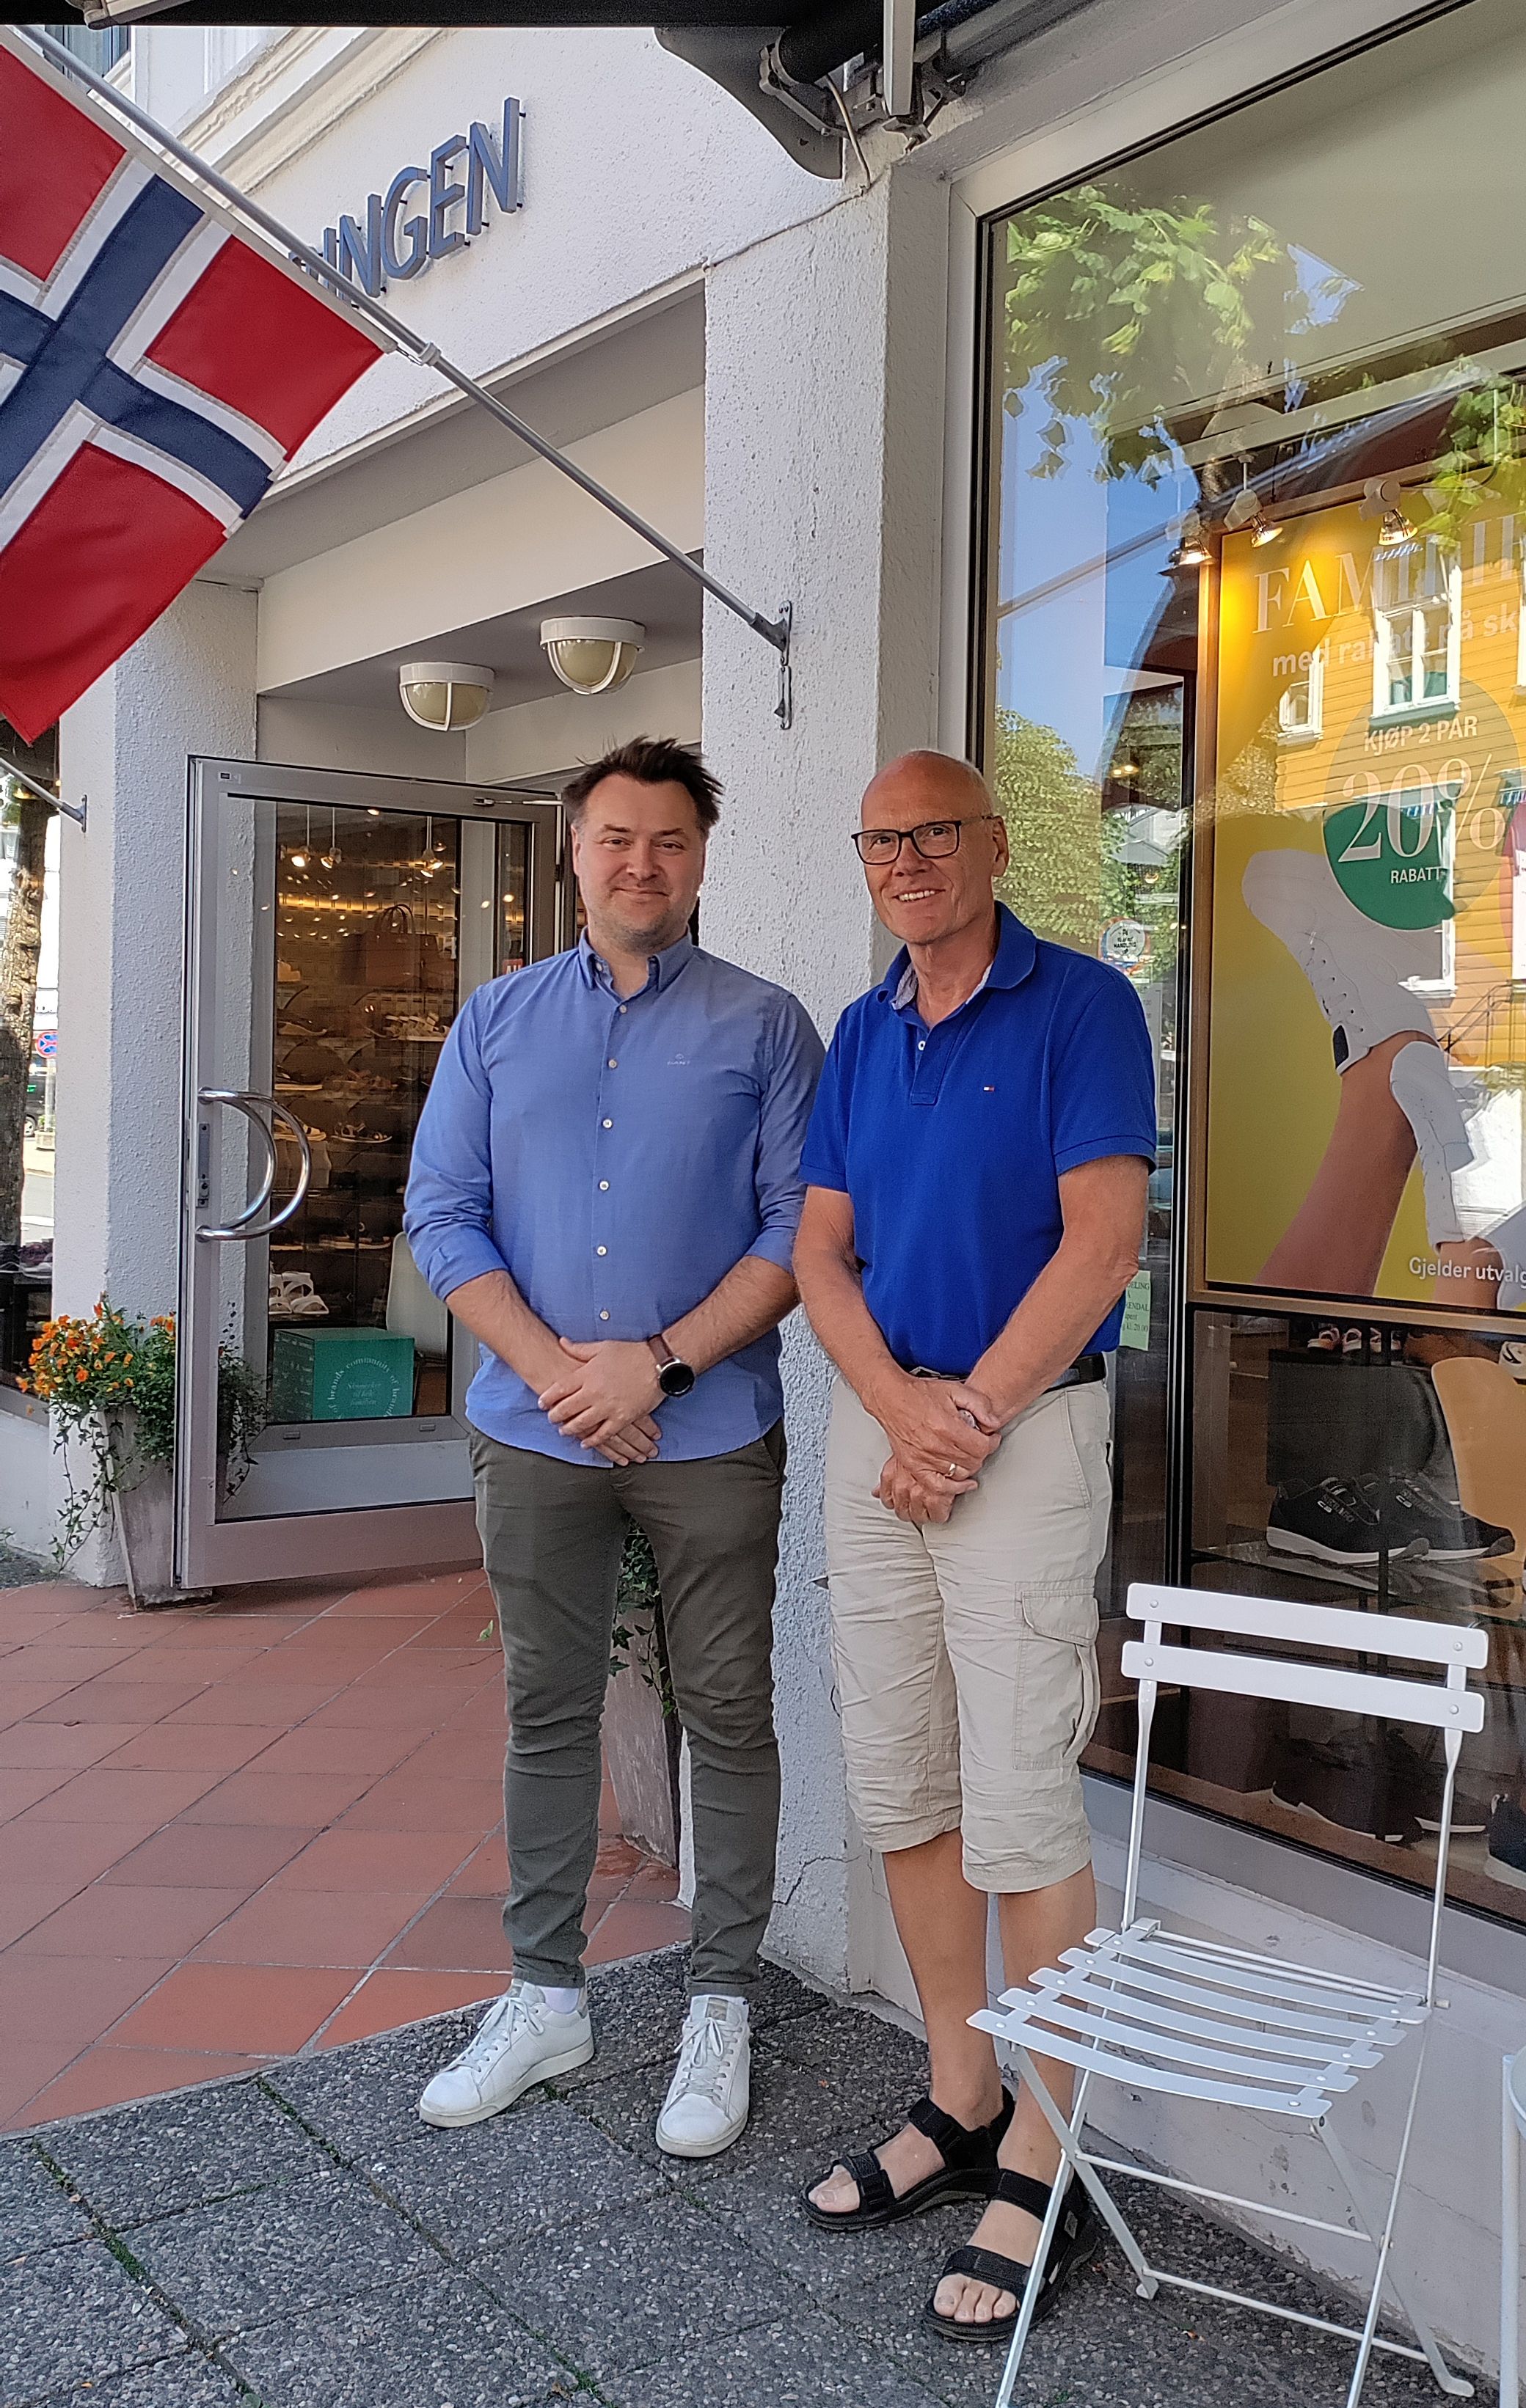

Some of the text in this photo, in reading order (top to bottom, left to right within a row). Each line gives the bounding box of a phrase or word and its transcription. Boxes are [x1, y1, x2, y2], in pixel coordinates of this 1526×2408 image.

[1272, 637, 1330, 677] med
[1364, 715, 1478, 756] KJØP 2 PAR
[1338, 753, 1506, 863] 20%
[1390, 866, 1443, 885] RABATT
[1409, 1256, 1472, 1280] Gjelder
